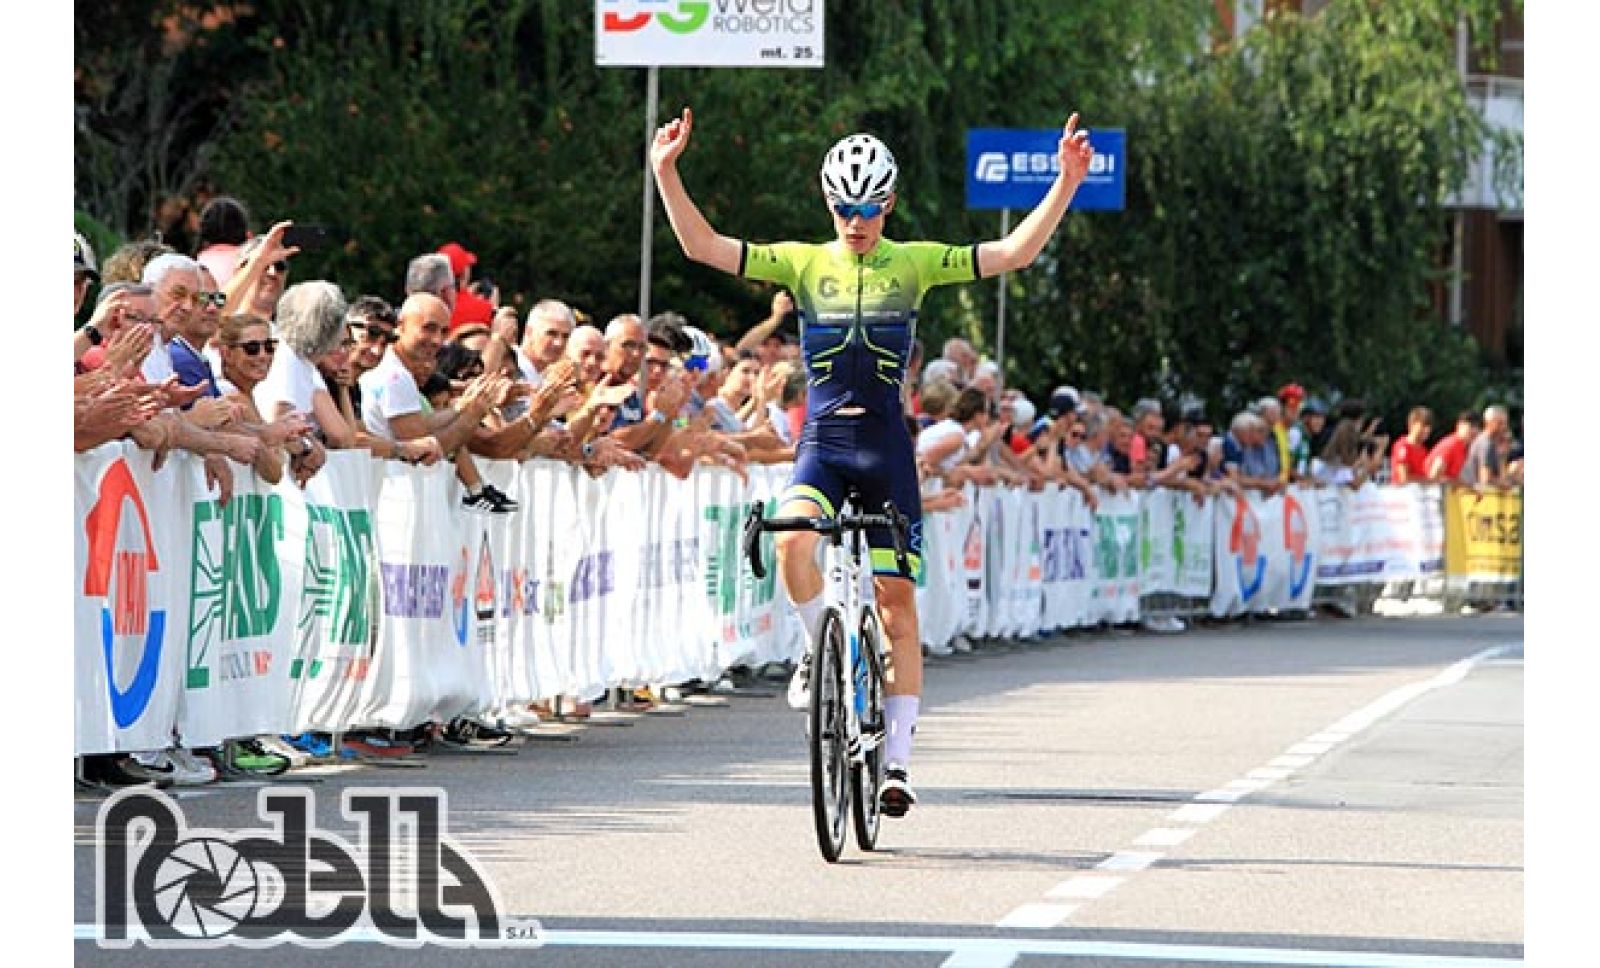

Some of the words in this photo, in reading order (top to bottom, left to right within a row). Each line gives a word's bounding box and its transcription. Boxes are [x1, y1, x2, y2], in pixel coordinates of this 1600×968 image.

[713, 16, 815, 34] ROBOTICS
[760, 47, 787, 58] mt.
[793, 46, 813, 58] 25
